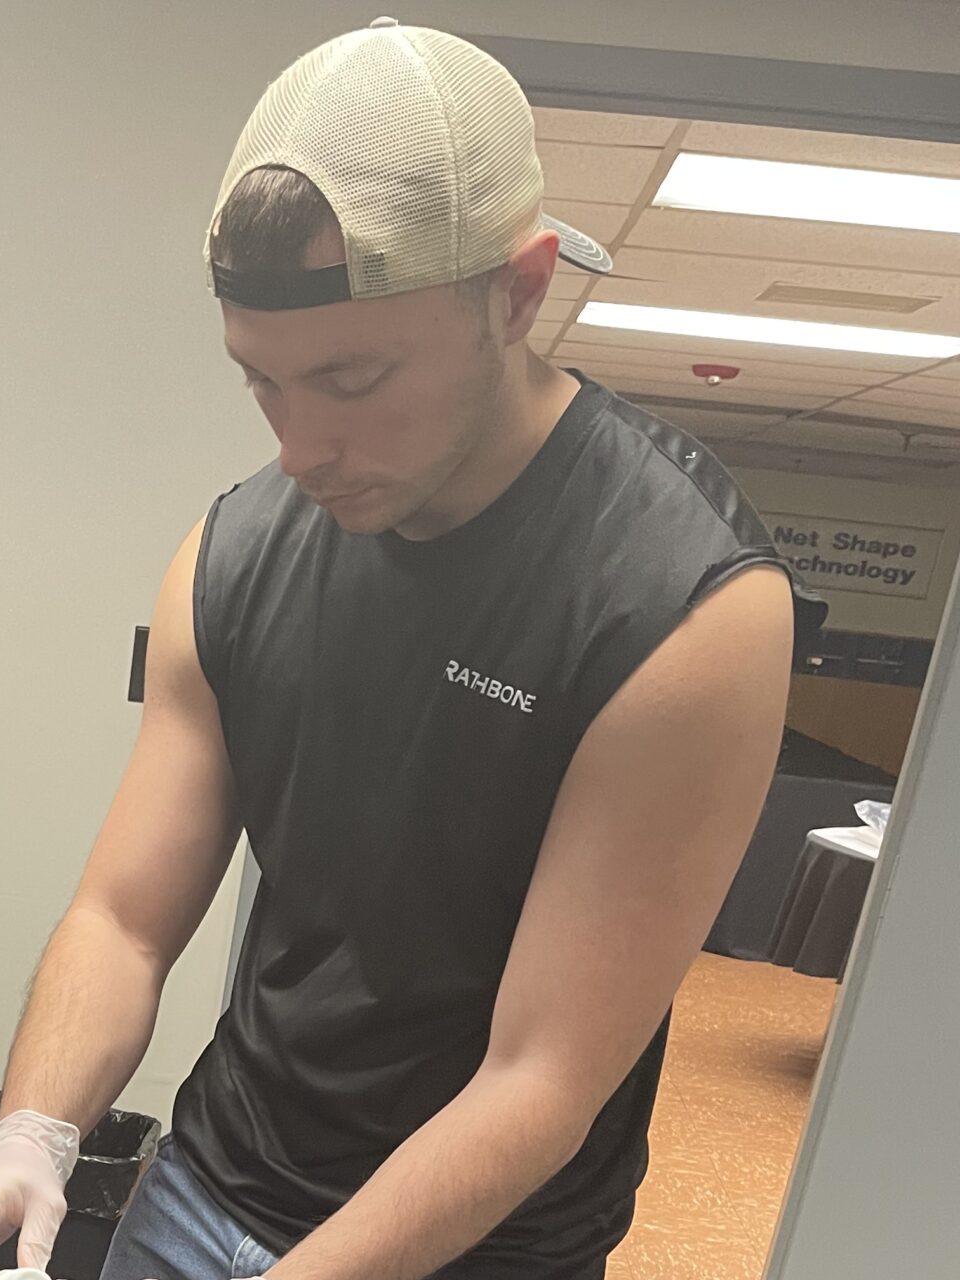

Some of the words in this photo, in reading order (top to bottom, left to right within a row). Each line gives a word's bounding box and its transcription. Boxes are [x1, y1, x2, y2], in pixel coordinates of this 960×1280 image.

[774, 525, 820, 548] Net
[832, 532, 917, 558] Shape
[788, 555, 916, 586] chnology
[443, 659, 537, 713] RATHBONE
